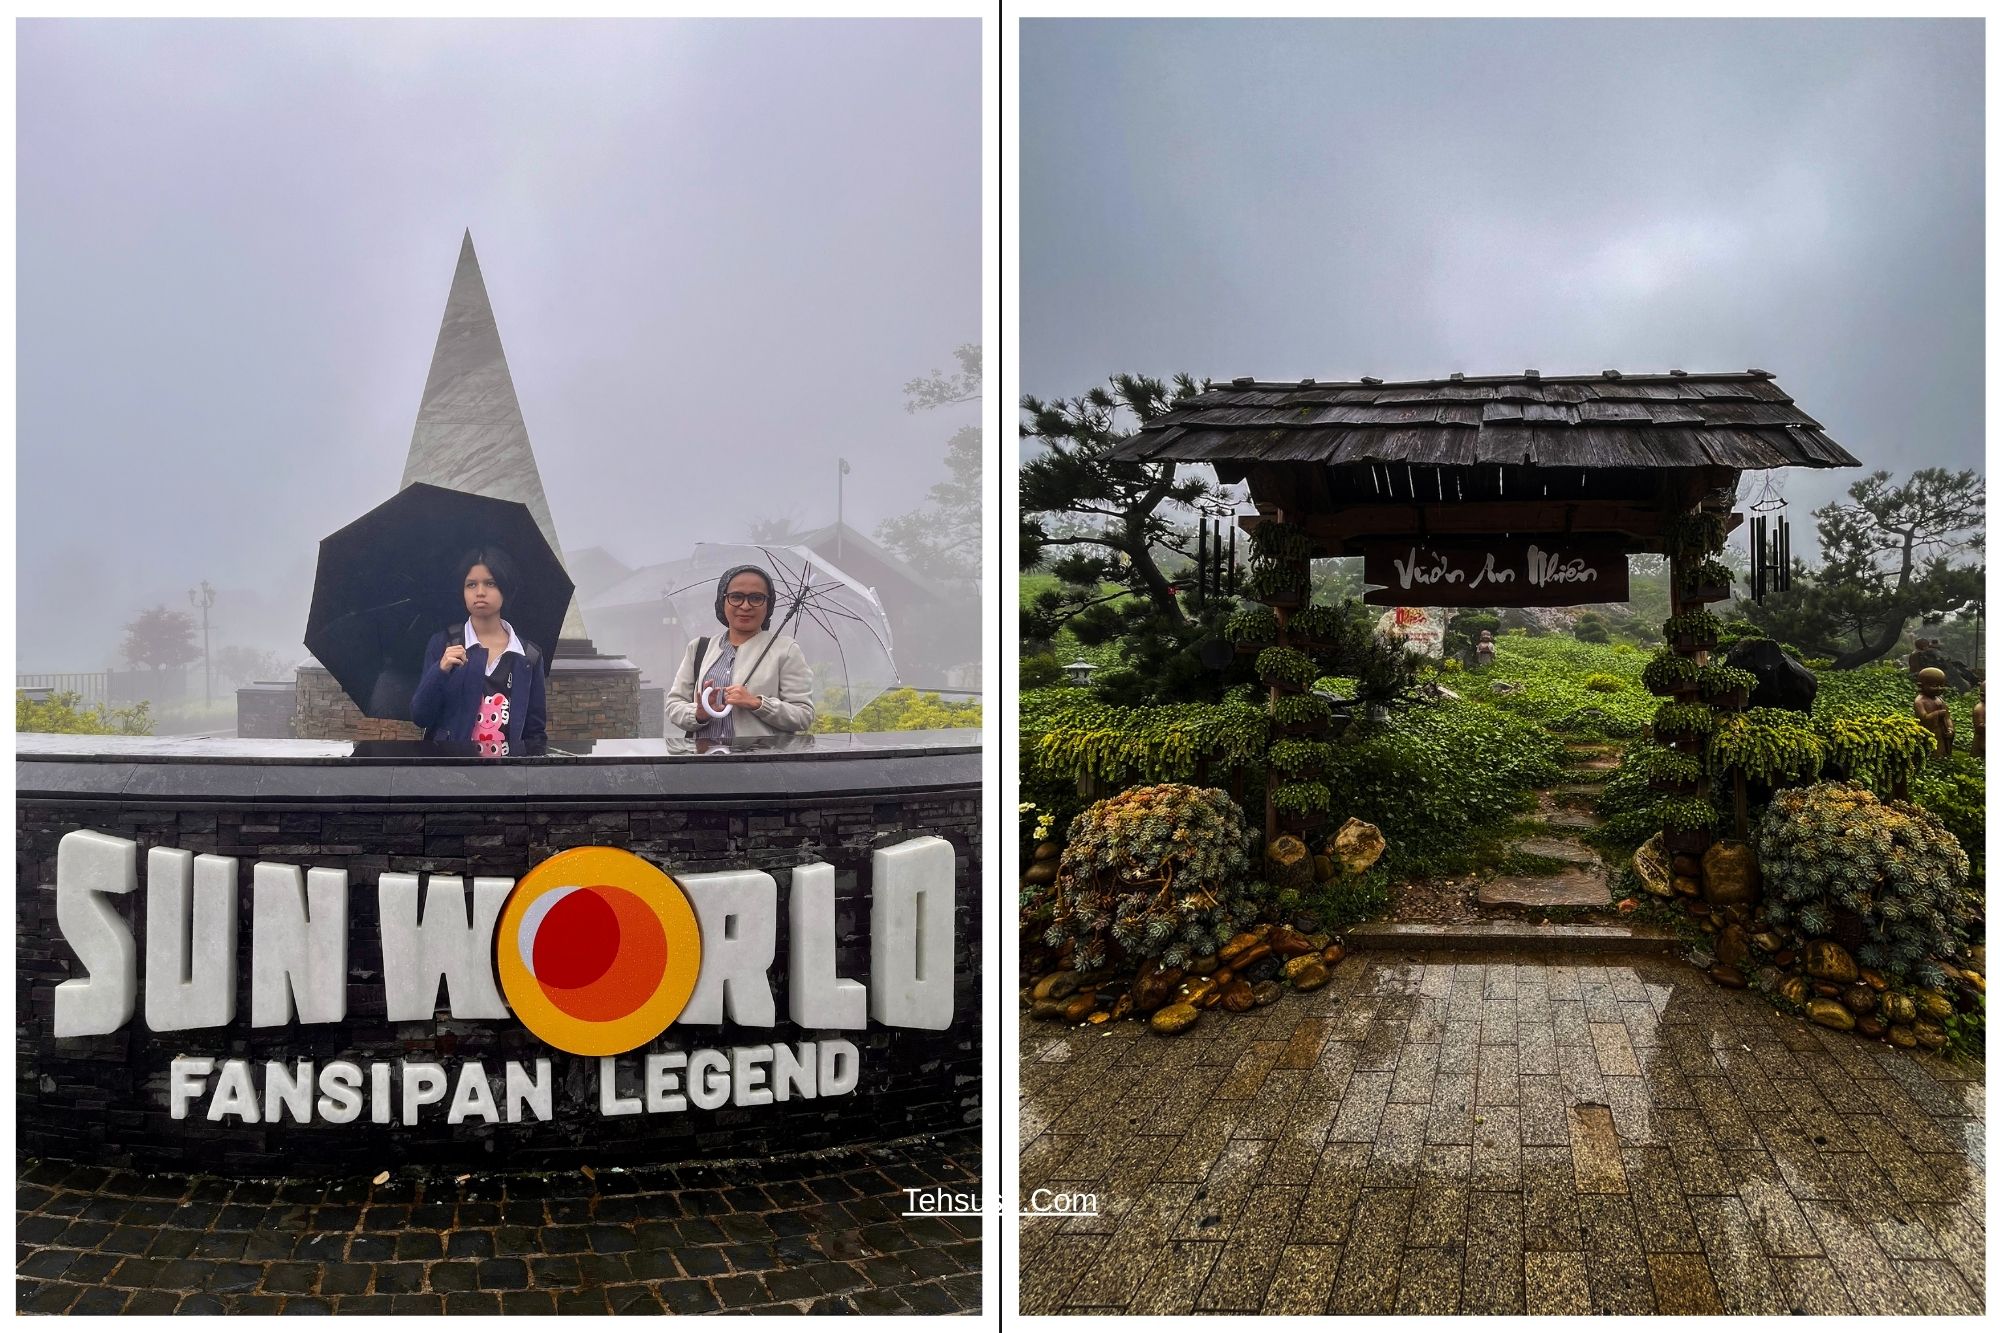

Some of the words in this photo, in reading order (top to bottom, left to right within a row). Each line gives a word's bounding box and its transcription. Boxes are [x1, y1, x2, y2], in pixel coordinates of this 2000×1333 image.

[1469, 552, 1515, 589] An
[54, 829, 348, 1037] SUN
[170, 1056, 553, 1126] FANSIPAN
[599, 1038, 859, 1116] LEGEND
